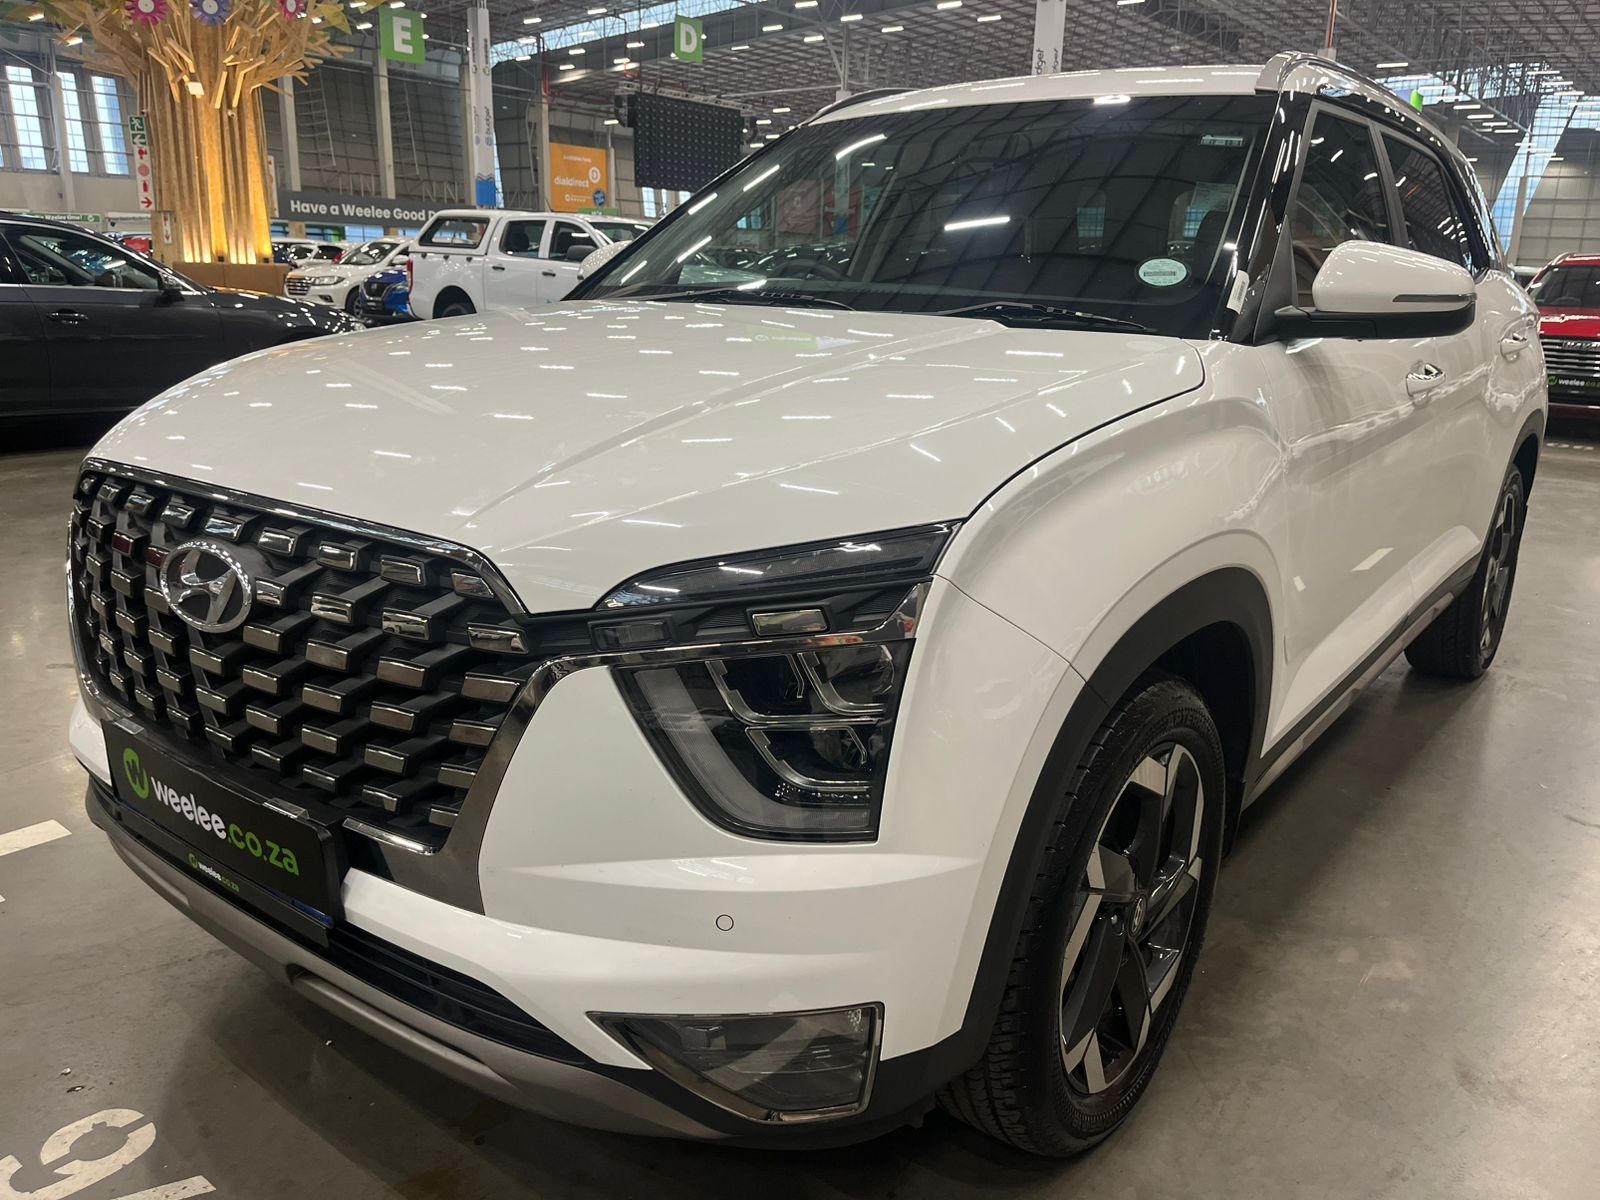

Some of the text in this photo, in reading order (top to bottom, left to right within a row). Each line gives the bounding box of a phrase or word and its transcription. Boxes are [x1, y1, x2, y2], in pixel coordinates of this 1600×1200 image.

[393, 16, 413, 54] E
[680, 22, 697, 53] D
[290, 200, 327, 215] Have
[330, 205, 339, 215] a
[342, 204, 391, 219] Weelee
[393, 207, 426, 221] Good
[150, 776, 299, 876] weelee.co.za
